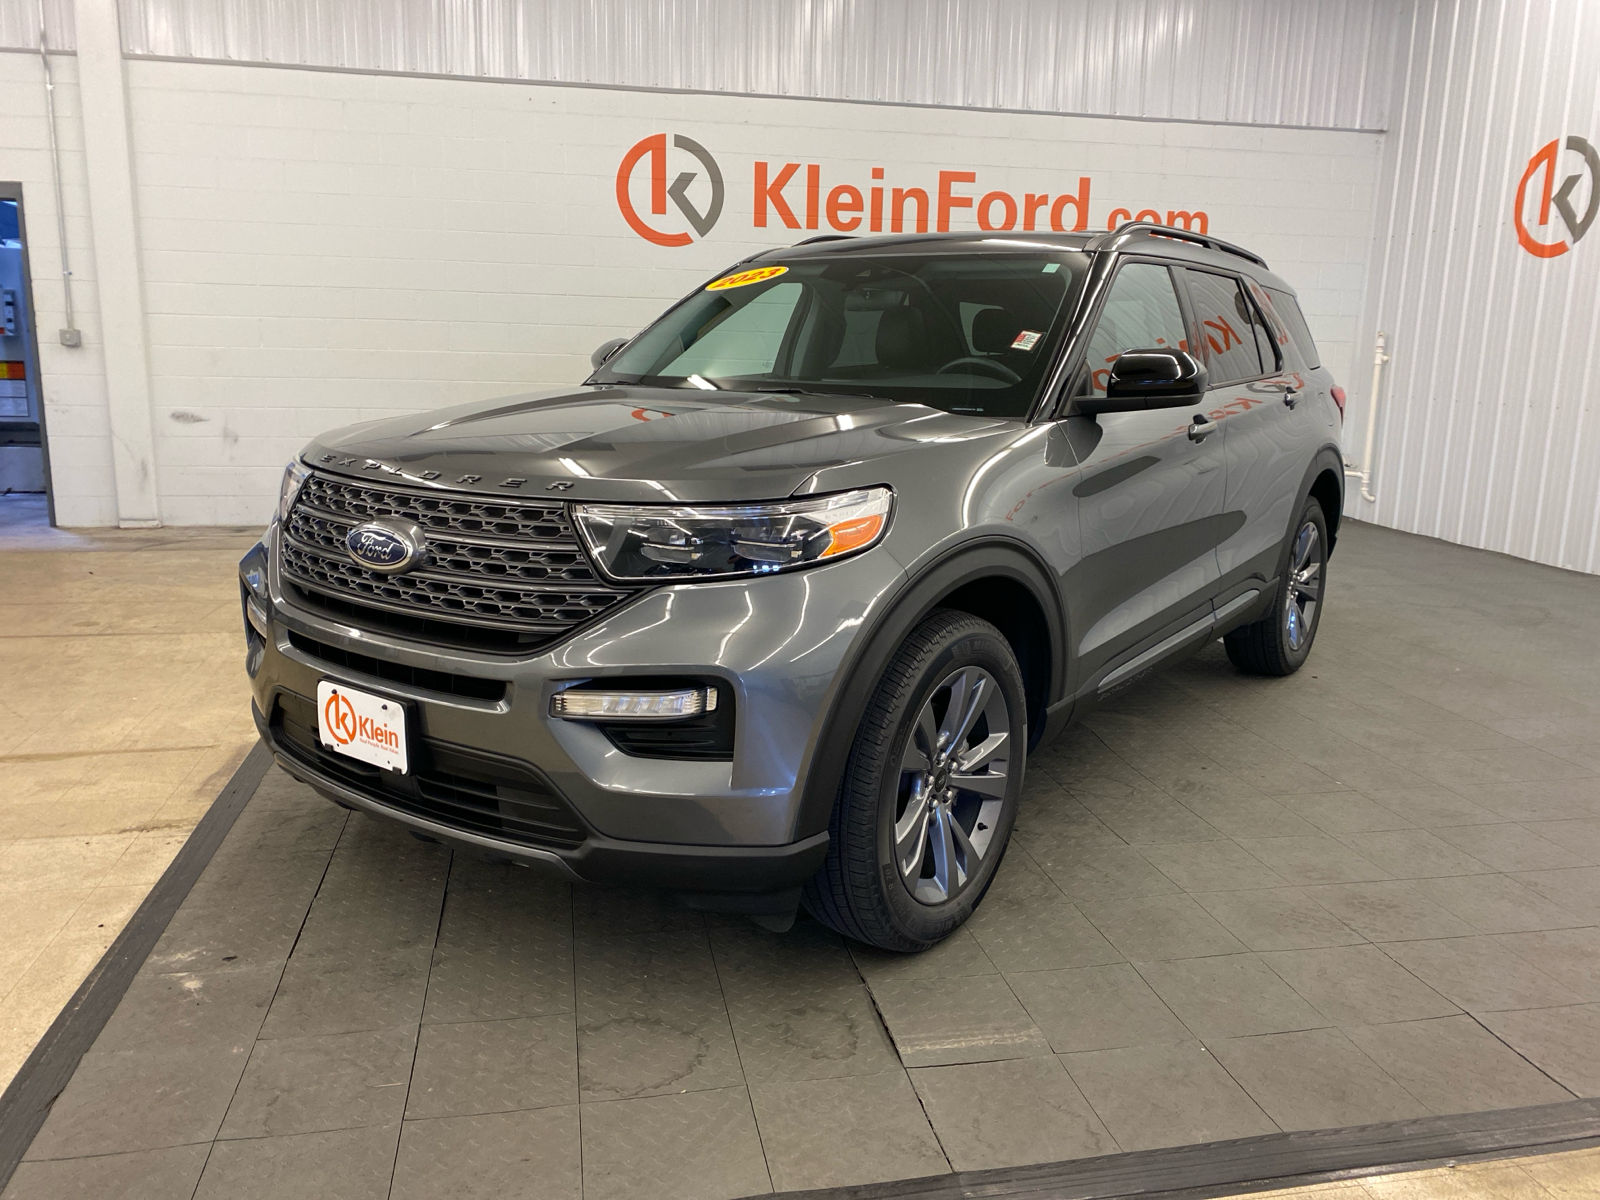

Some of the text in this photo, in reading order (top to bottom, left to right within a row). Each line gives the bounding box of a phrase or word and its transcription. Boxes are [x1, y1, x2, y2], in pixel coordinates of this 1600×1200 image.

[711, 267, 782, 289] 2023
[320, 453, 574, 491] EXPLORER
[357, 531, 392, 560] Ford
[358, 715, 399, 748] Klein
